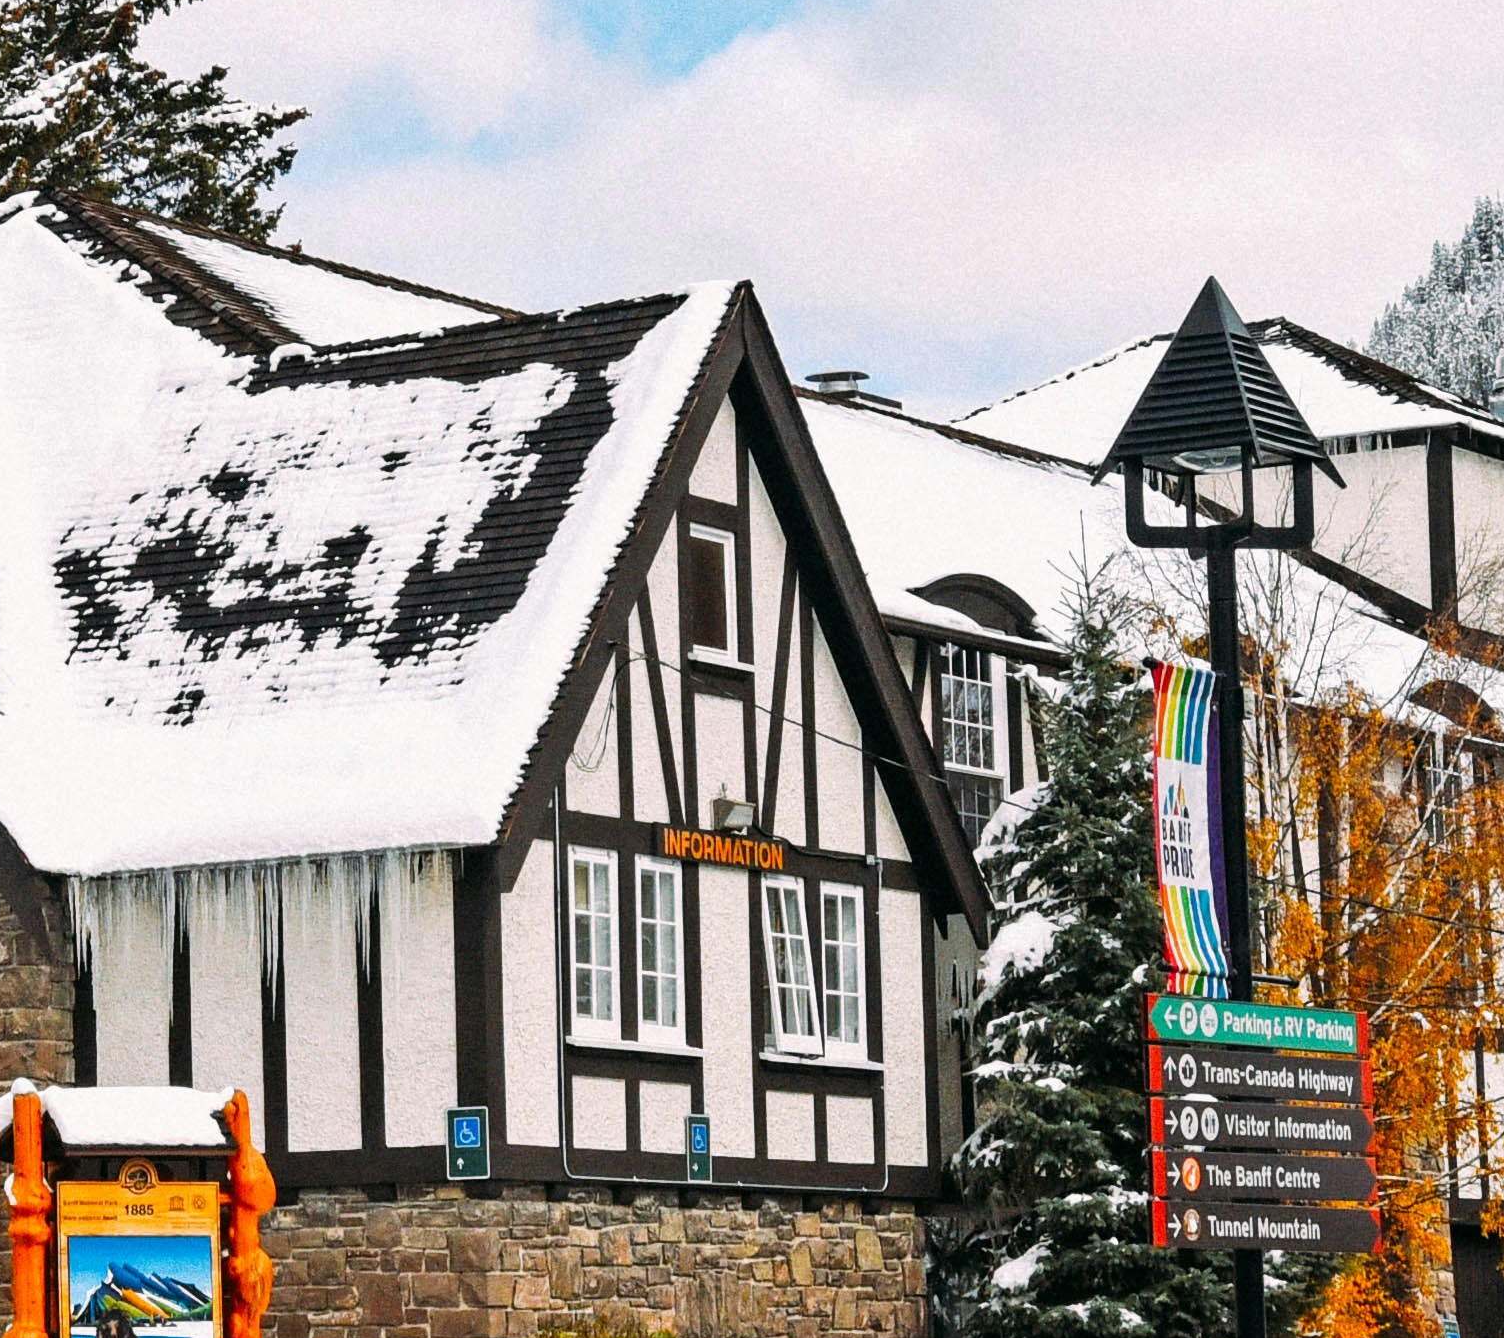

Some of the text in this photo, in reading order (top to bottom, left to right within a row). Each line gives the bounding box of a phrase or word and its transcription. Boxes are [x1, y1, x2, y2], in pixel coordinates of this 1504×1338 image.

[664, 827, 784, 870] INFORMATION
[1163, 844, 1195, 880] PRIDE
[1223, 1011, 1272, 1041] Parking
[1273, 1018, 1282, 1036] &
[1285, 1018, 1304, 1038] RV
[1307, 1018, 1354, 1046] Parking
[1202, 1061, 1295, 1089] Trans-Canada
[1298, 1068, 1354, 1096] Highway
[1225, 1114, 1352, 1141] Visitor Information
[1206, 1164, 1321, 1189] The Banff Centre
[124, 1204, 154, 1216] 1885
[1208, 1215, 1321, 1240] Tunnel Mountain
